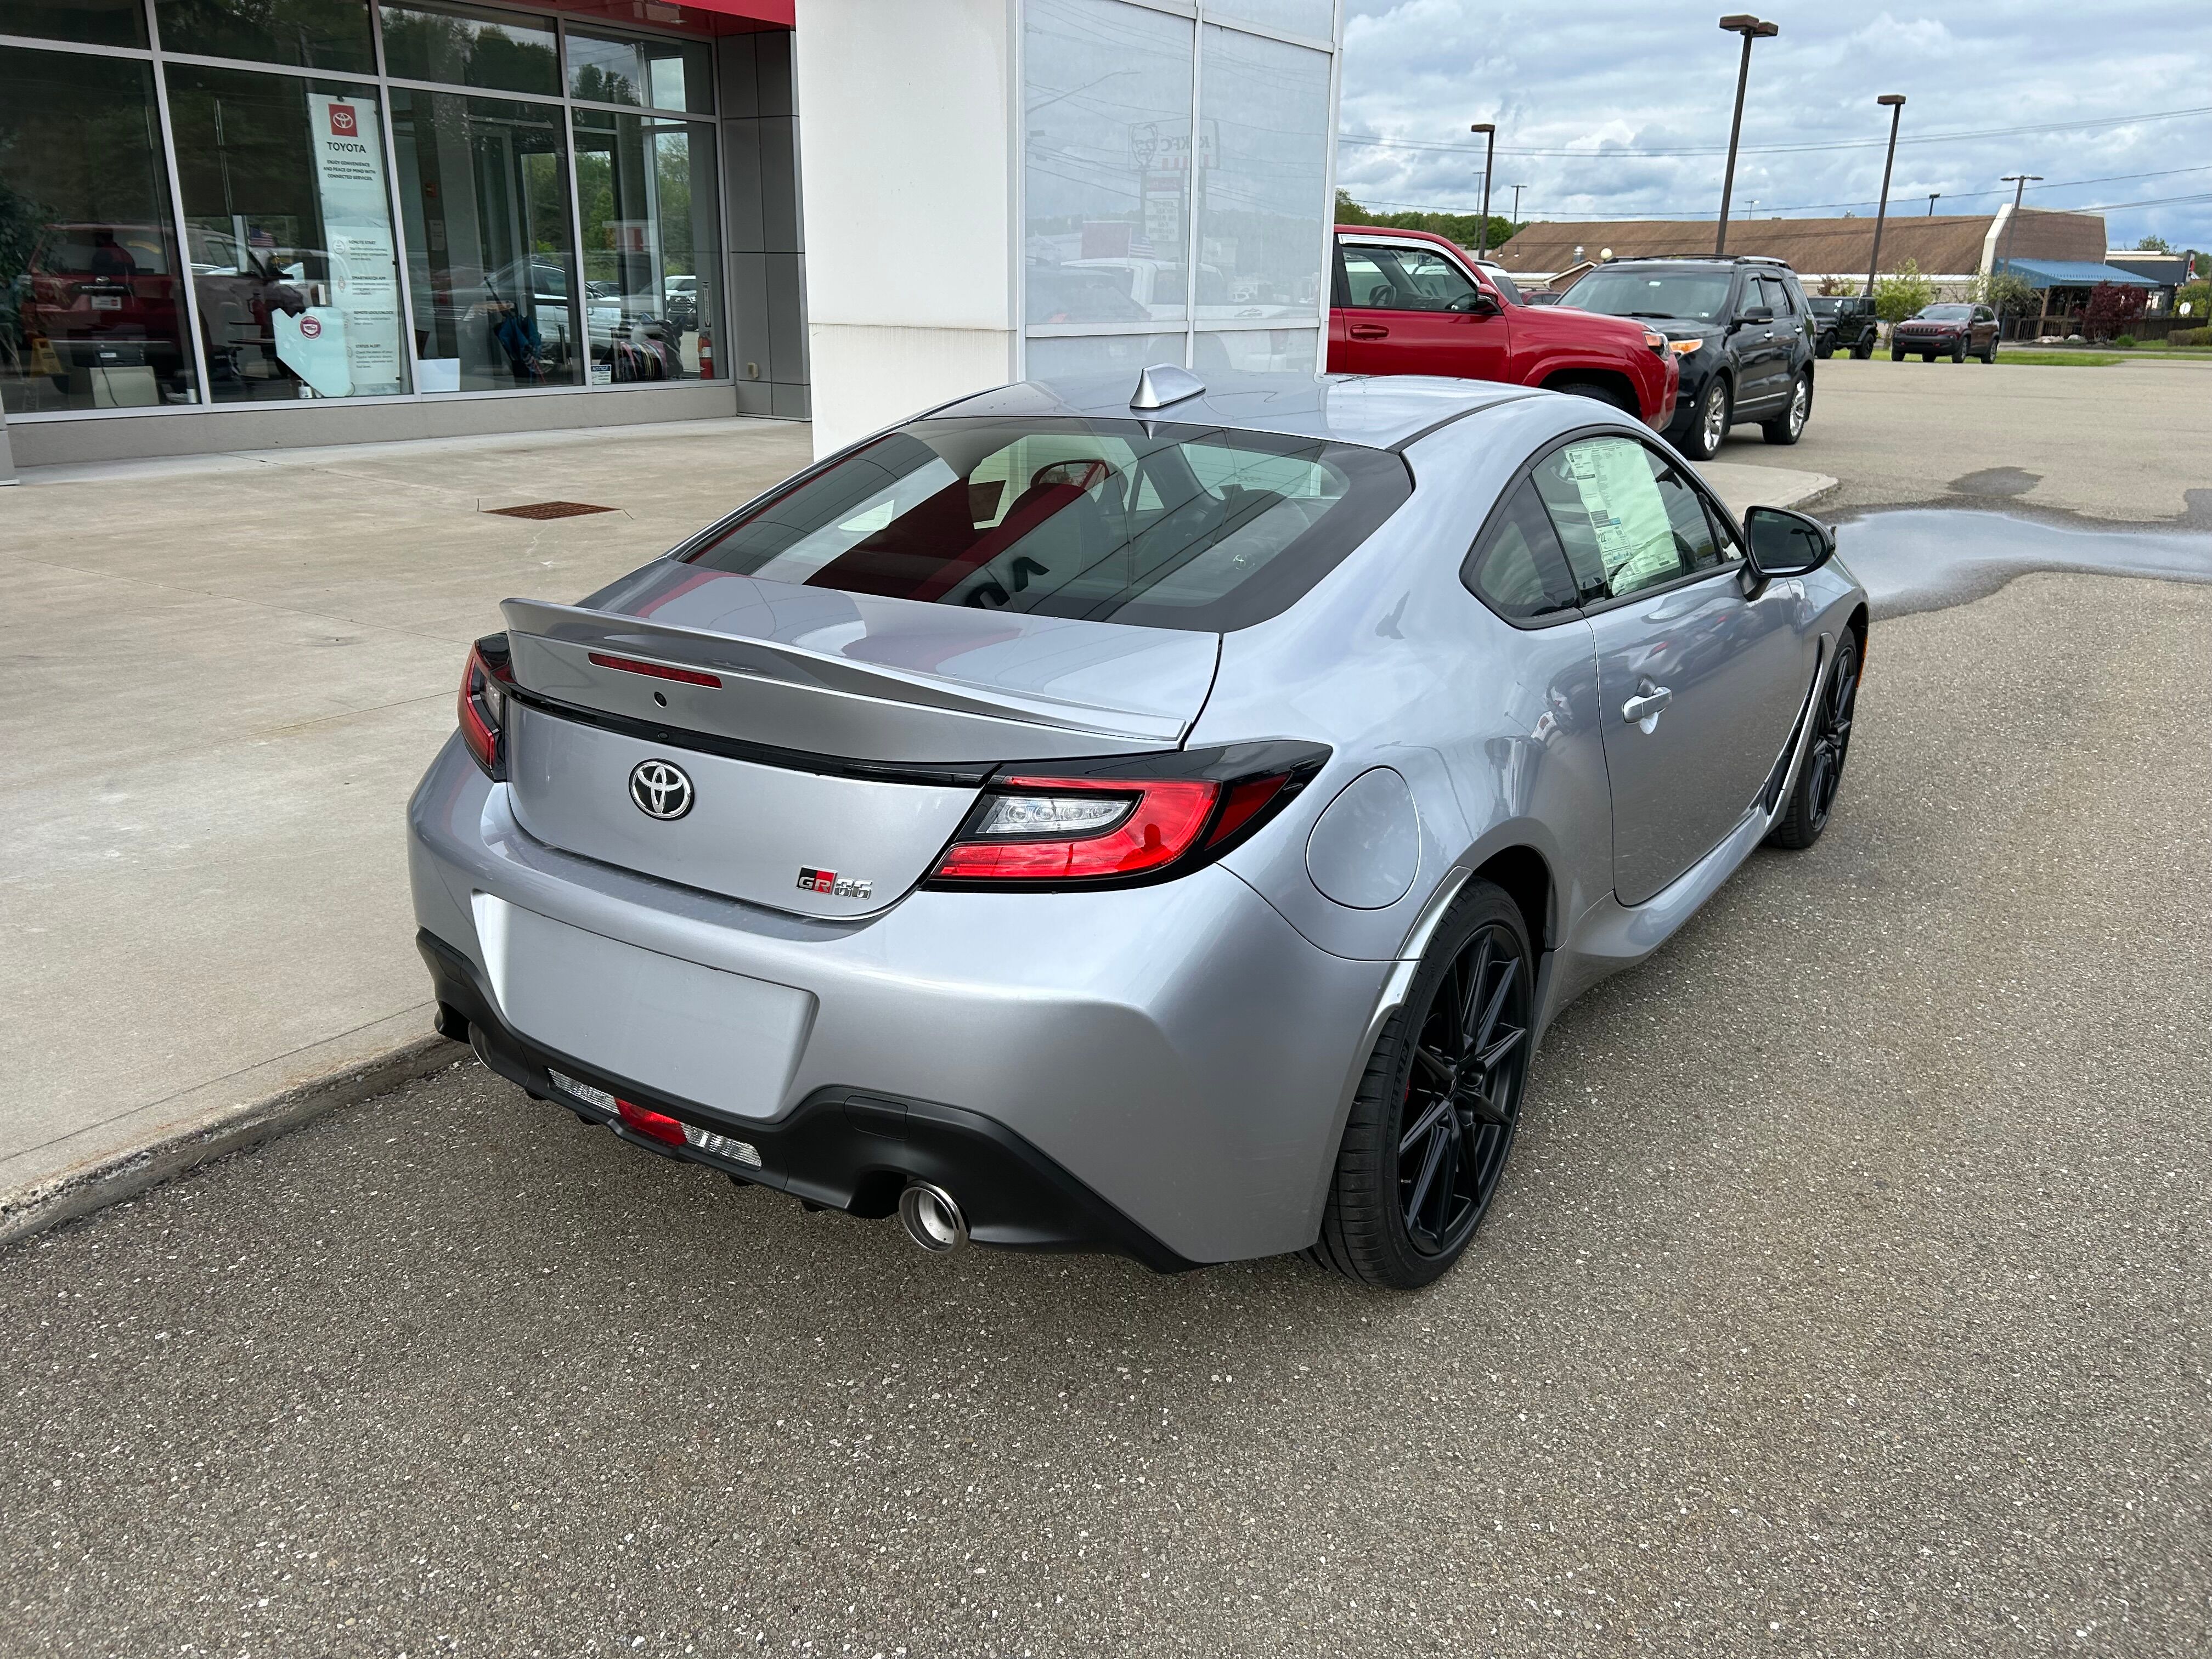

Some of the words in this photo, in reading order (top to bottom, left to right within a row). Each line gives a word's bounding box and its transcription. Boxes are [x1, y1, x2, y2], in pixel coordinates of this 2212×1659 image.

[326, 142, 366, 153] TOYOTA
[798, 876, 831, 893] GR
[834, 877, 873, 900] 86
